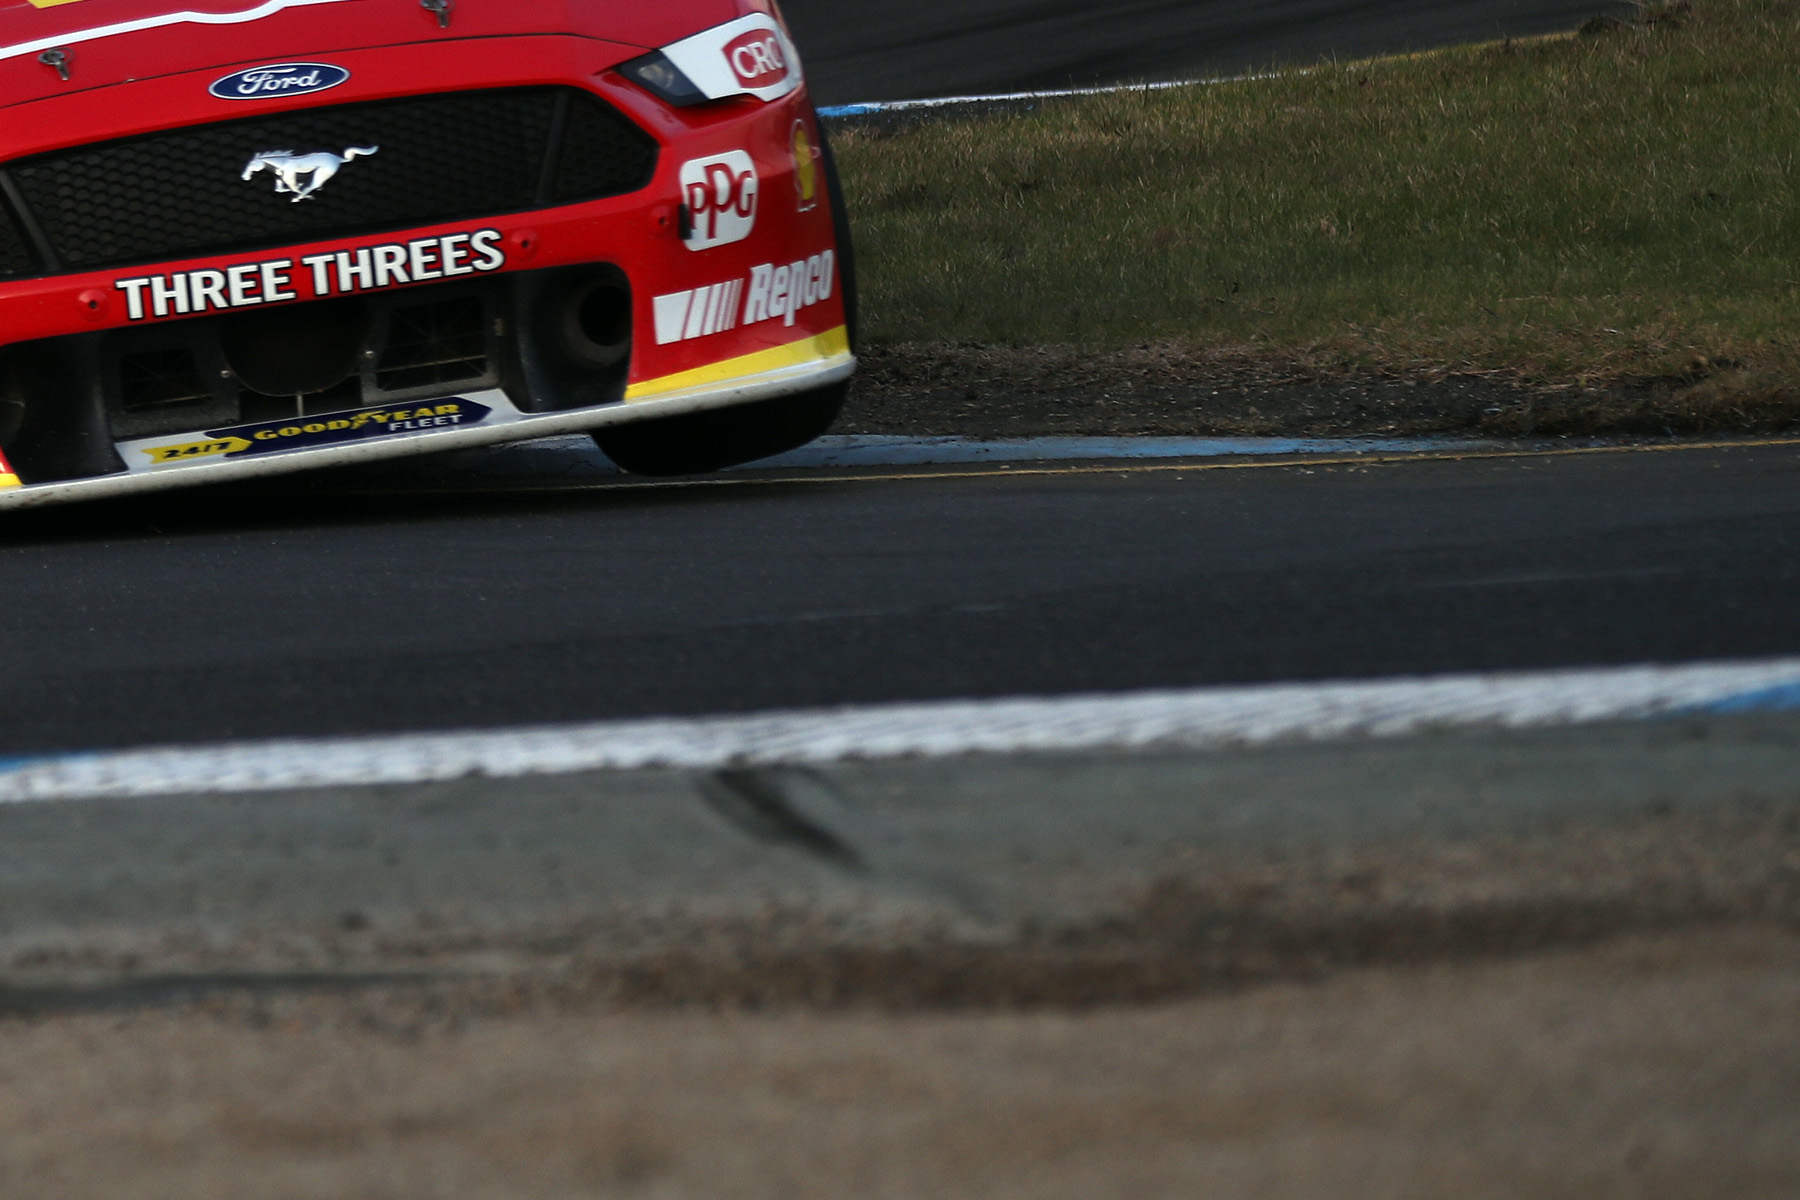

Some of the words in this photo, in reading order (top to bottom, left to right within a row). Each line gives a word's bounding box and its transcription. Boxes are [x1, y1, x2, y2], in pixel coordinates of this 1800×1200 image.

[732, 37, 783, 78] CRC
[237, 67, 321, 94] Ford
[116, 260, 296, 319] THREE
[303, 230, 504, 296] THREES
[743, 250, 833, 327] Repco
[388, 414, 464, 432] FLEET
[163, 441, 233, 459] 24/7
